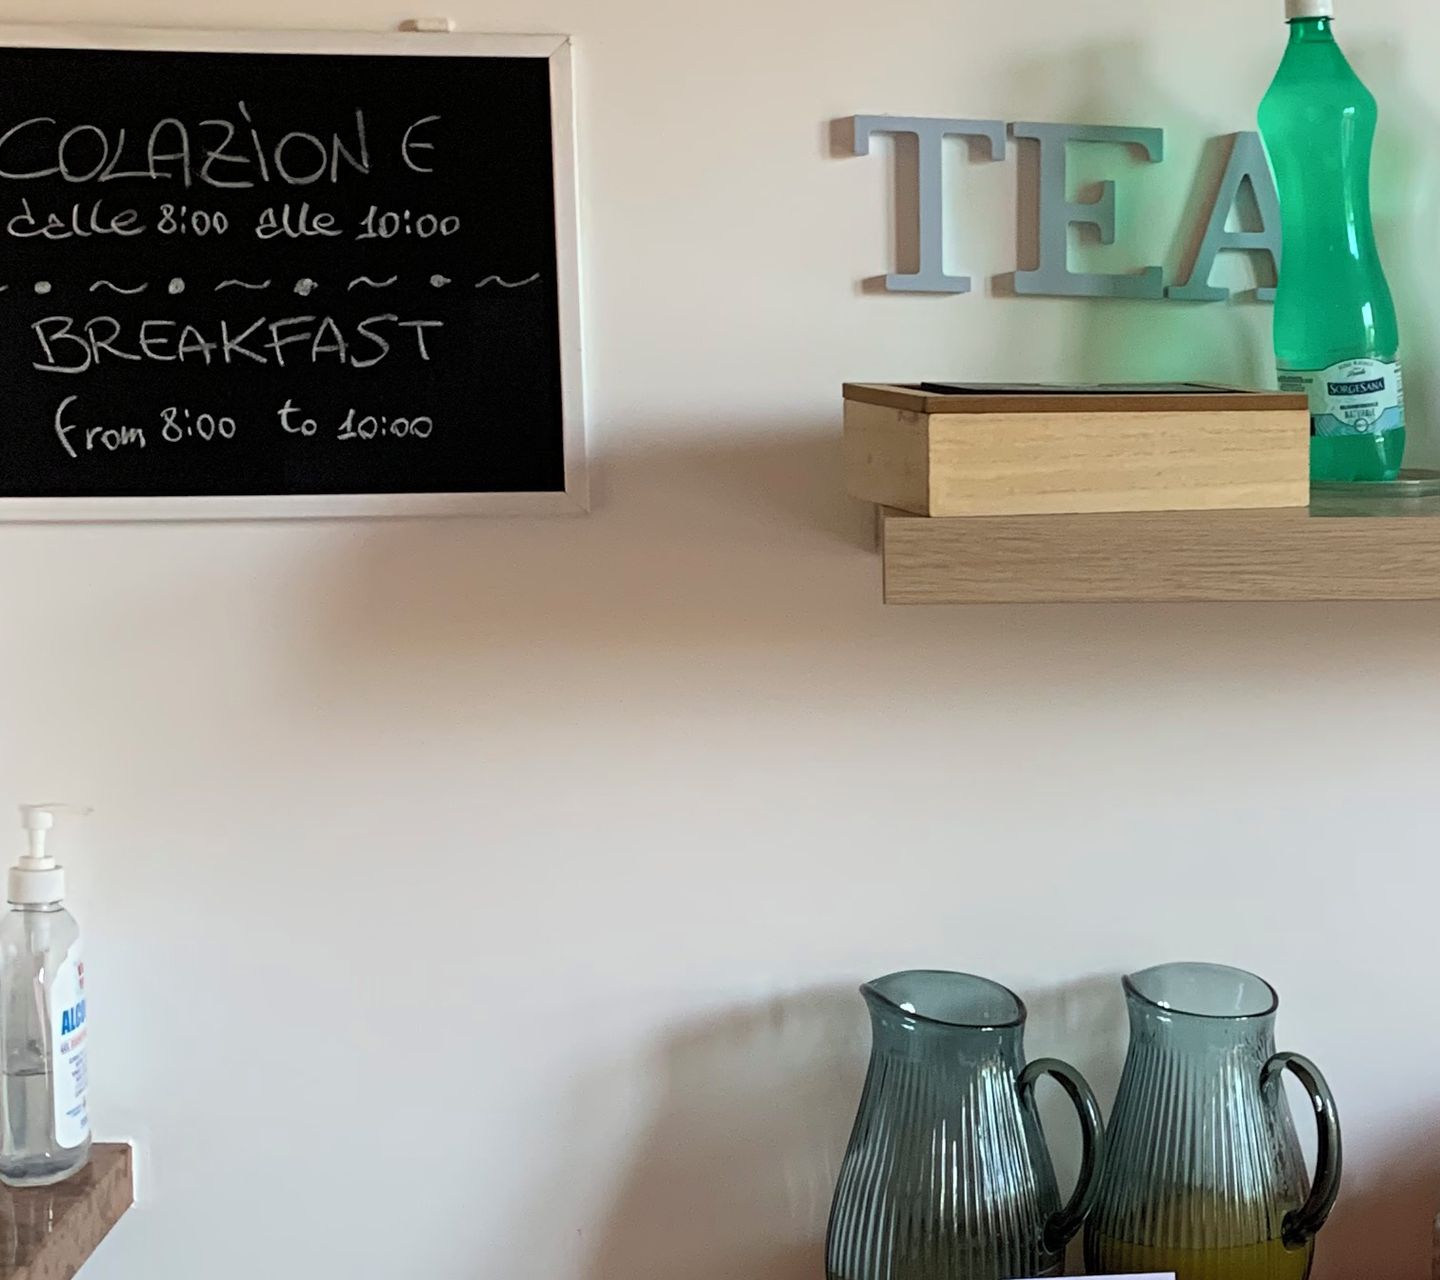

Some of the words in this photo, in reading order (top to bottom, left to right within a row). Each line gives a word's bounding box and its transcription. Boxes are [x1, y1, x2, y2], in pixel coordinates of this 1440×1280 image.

[6, 198, 147, 238] dalle
[156, 203, 229, 237] 8:00
[256, 202, 344, 240] alle
[355, 205, 460, 240] 10:00
[852, 113, 1283, 302] TEA
[31, 314, 444, 374] BREAKFAST
[54, 395, 146, 458] from
[160, 408, 237, 442] 8:00
[277, 398, 318, 437] to
[337, 408, 433, 441] 10:00
